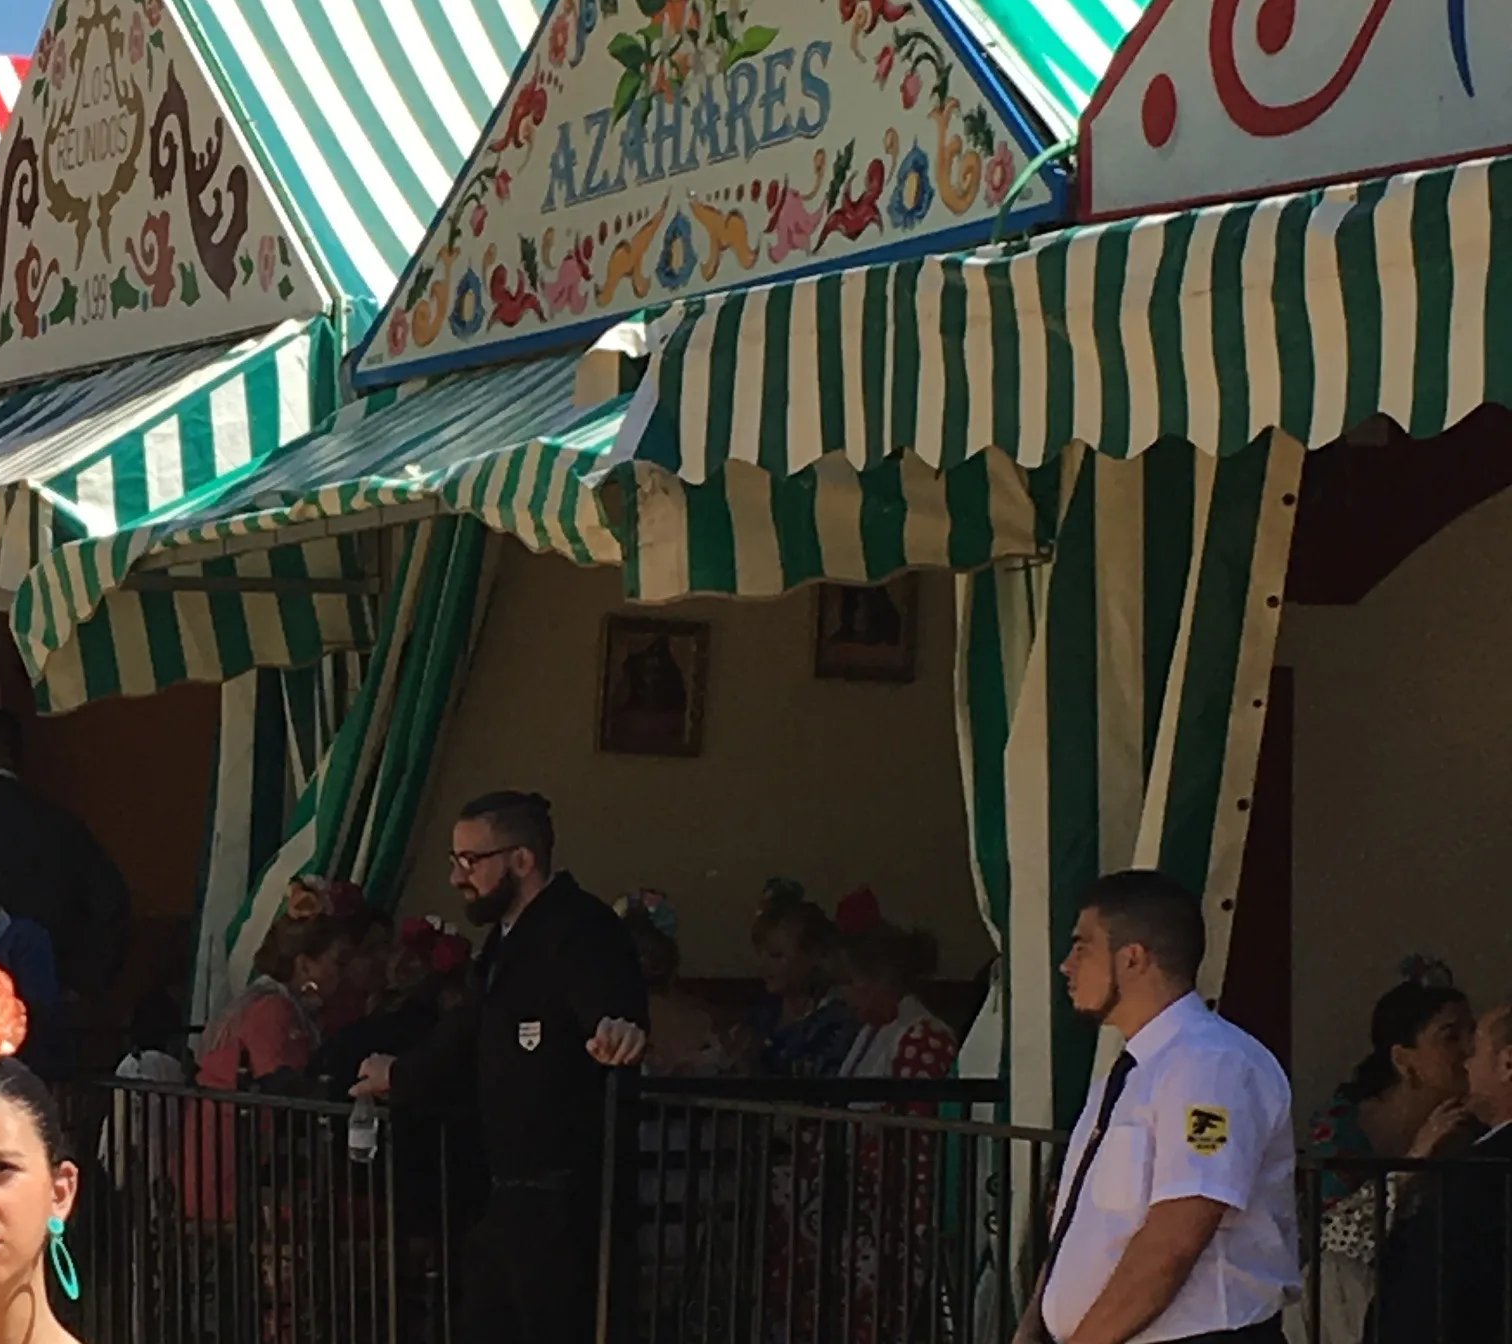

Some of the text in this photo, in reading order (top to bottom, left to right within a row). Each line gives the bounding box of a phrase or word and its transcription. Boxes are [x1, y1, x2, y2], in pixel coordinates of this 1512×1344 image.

[82, 63, 112, 108] LOS
[540, 40, 832, 214] AZAHARES
[81, 273, 107, 325] 199
